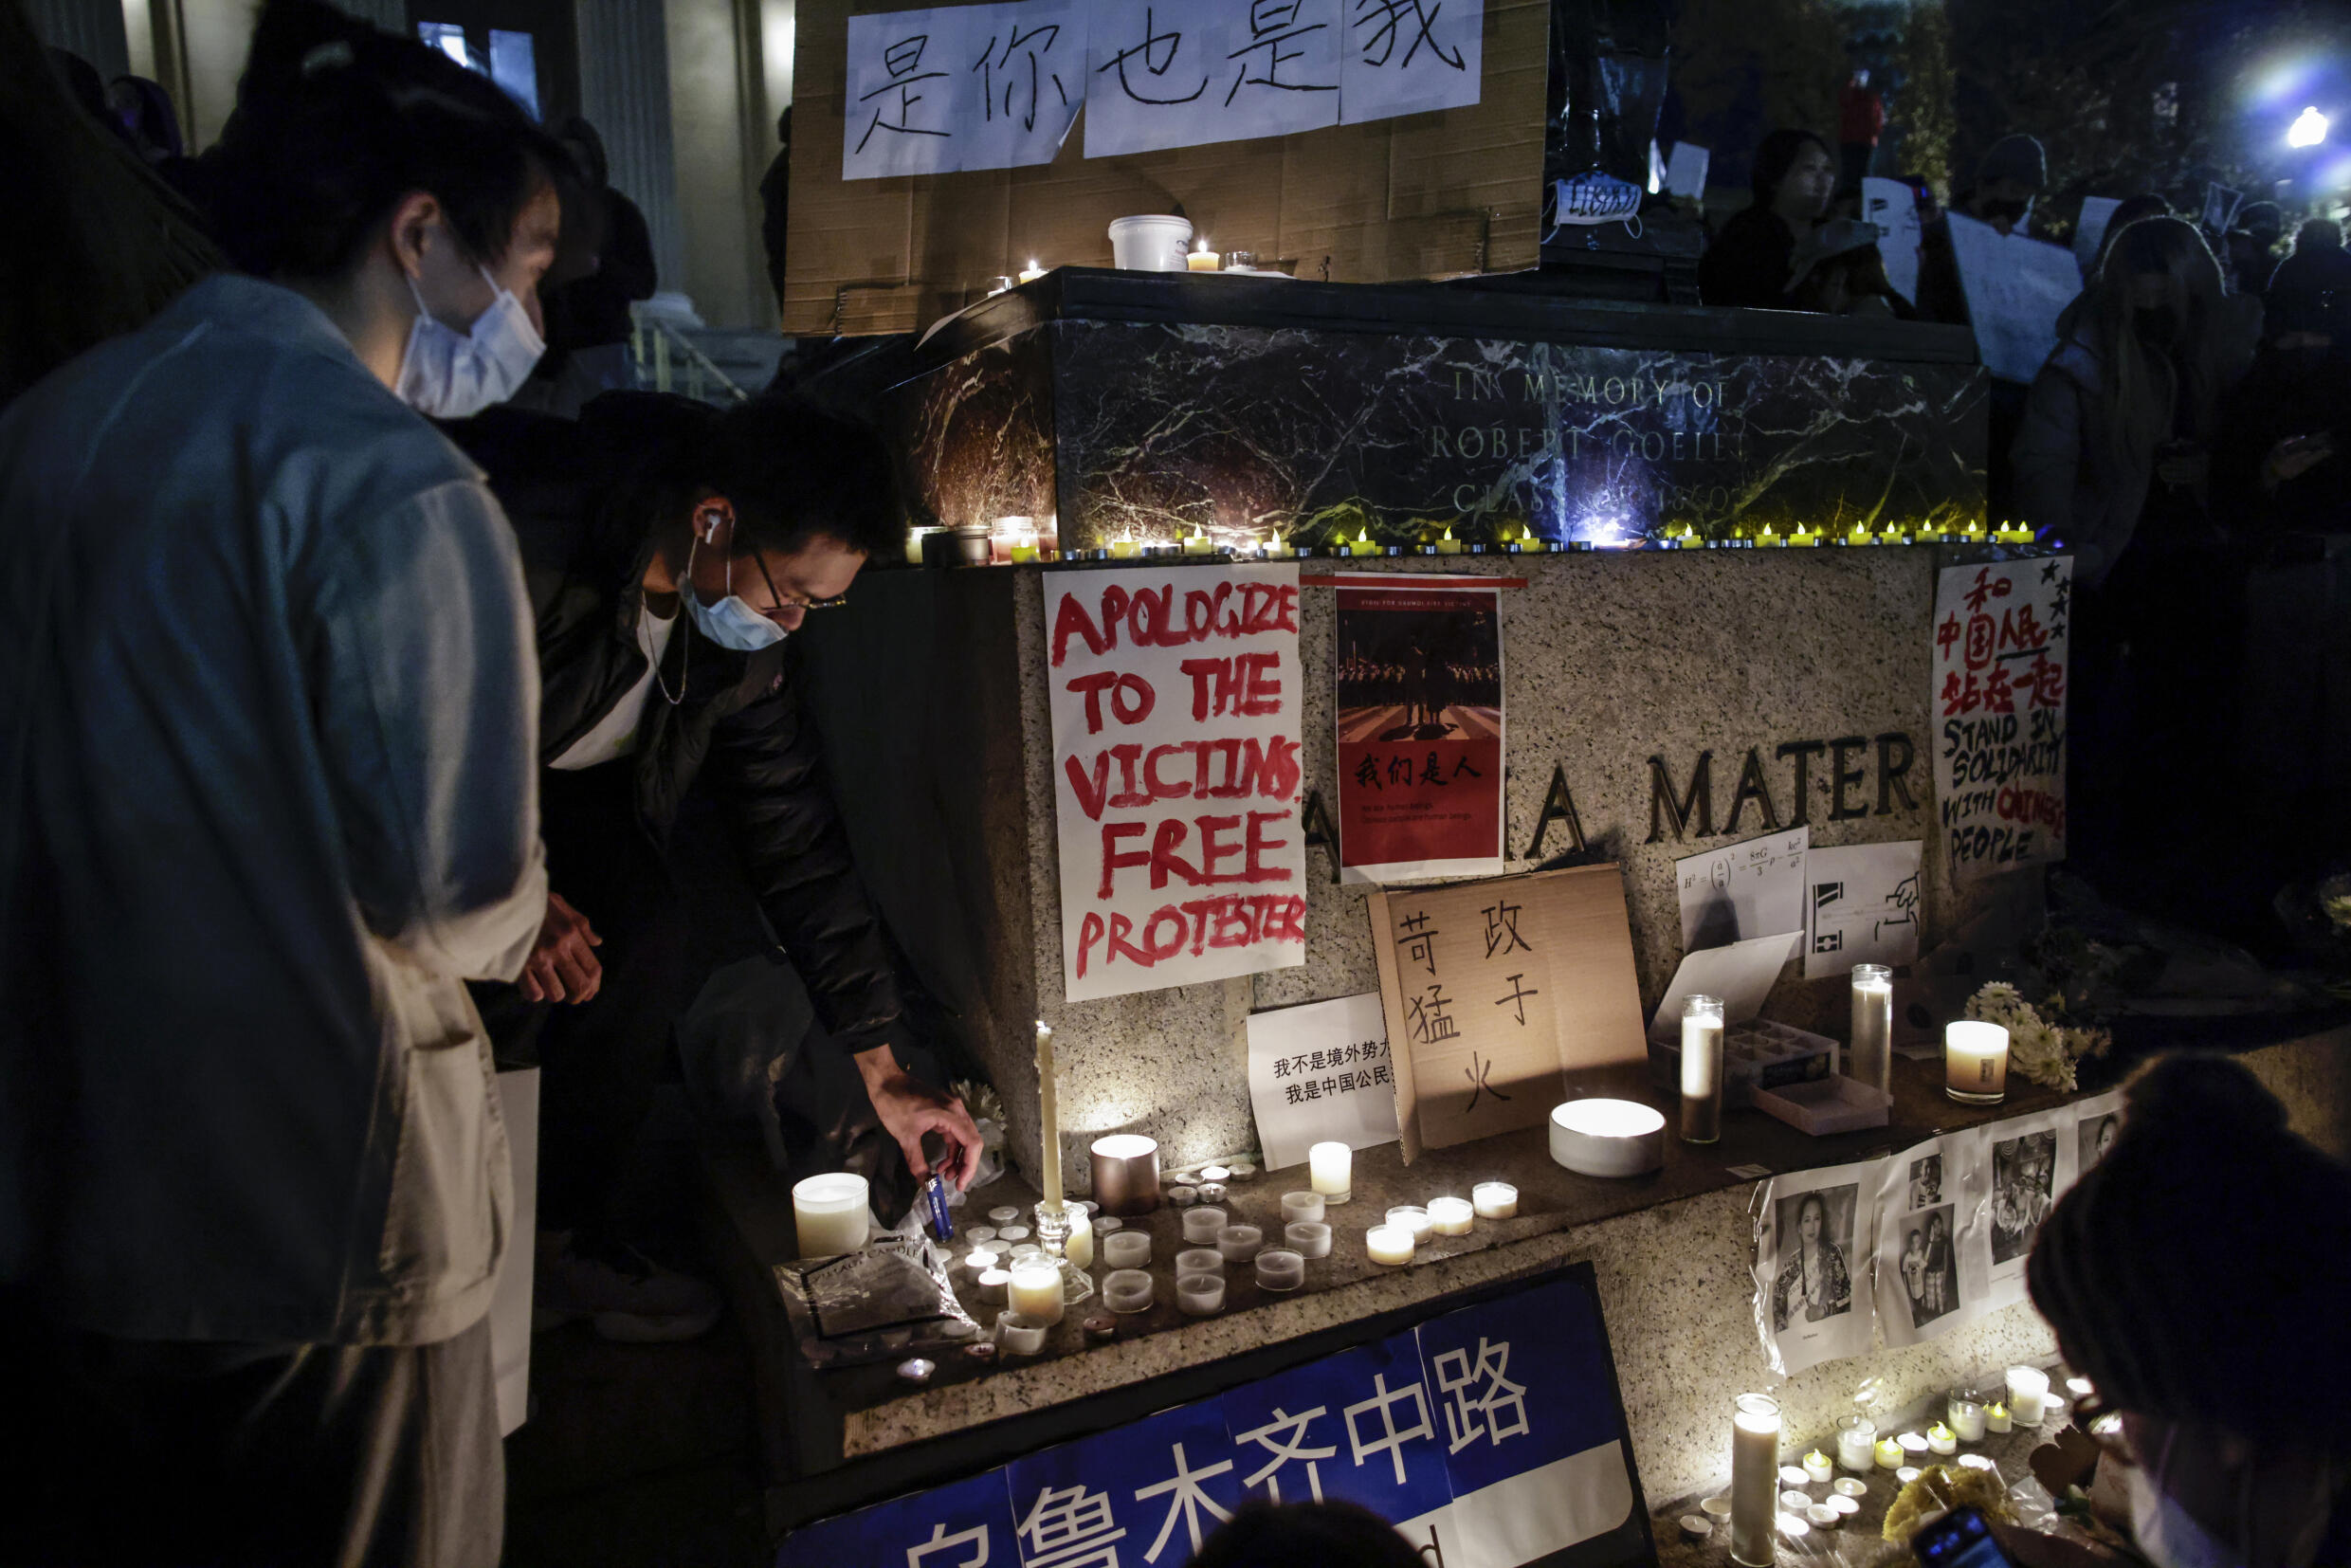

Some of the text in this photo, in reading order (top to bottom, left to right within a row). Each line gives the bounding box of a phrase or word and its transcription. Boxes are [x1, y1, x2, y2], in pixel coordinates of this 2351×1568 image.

[1453, 372, 1728, 408] IN MEMORY OF
[1431, 425, 1581, 461] ROBERT
[1963, 566, 2013, 613] 和
[1050, 581, 1300, 667] APOLOGIZE
[1936, 603, 2049, 670] 中国人民
[1066, 650, 1283, 735] TO THE
[1940, 652, 2065, 716] 站在一起
[1943, 708, 2057, 758] STAND IN
[1953, 730, 2065, 789] SOLIDARITY
[1354, 751, 1483, 791] 我们是人
[1645, 731, 1923, 846] MATER
[1942, 789, 1996, 829] WITH
[1097, 810, 1294, 901] FREE
[1951, 826, 2034, 871] PEOPLE
[1077, 892, 1307, 980] PROTESTER
[1397, 899, 1533, 975] 苛政
[1407, 973, 1539, 1046] 猛于
[1273, 1037, 1391, 1079] 我不是境外势力
[1285, 1065, 1390, 1104] 我是中国公民
[1464, 1049, 1512, 1113] 火
